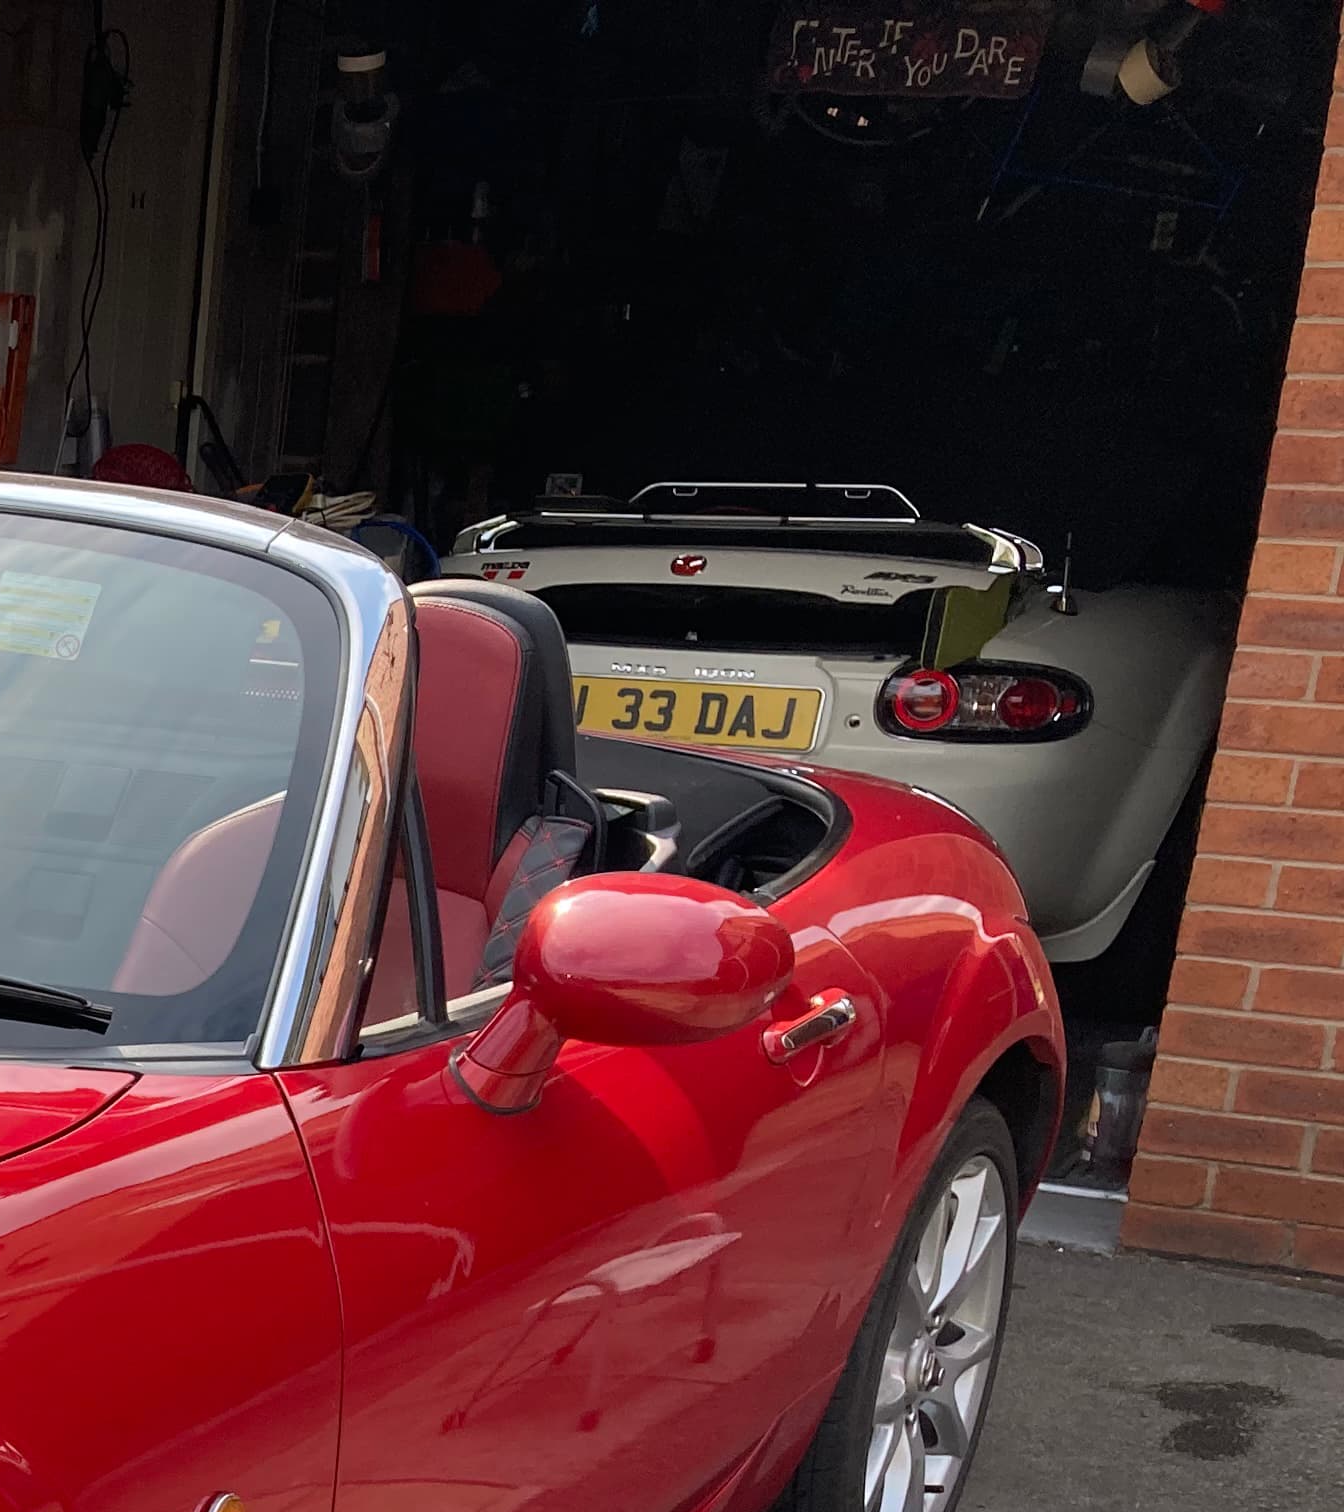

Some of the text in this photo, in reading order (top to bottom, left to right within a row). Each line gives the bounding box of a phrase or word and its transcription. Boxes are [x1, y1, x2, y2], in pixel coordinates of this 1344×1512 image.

[879, 19, 914, 55] IF
[903, 52, 949, 88] YOU
[953, 27, 1026, 85] DARE
[612, 687, 677, 732] 33
[694, 691, 797, 739] DAJ
